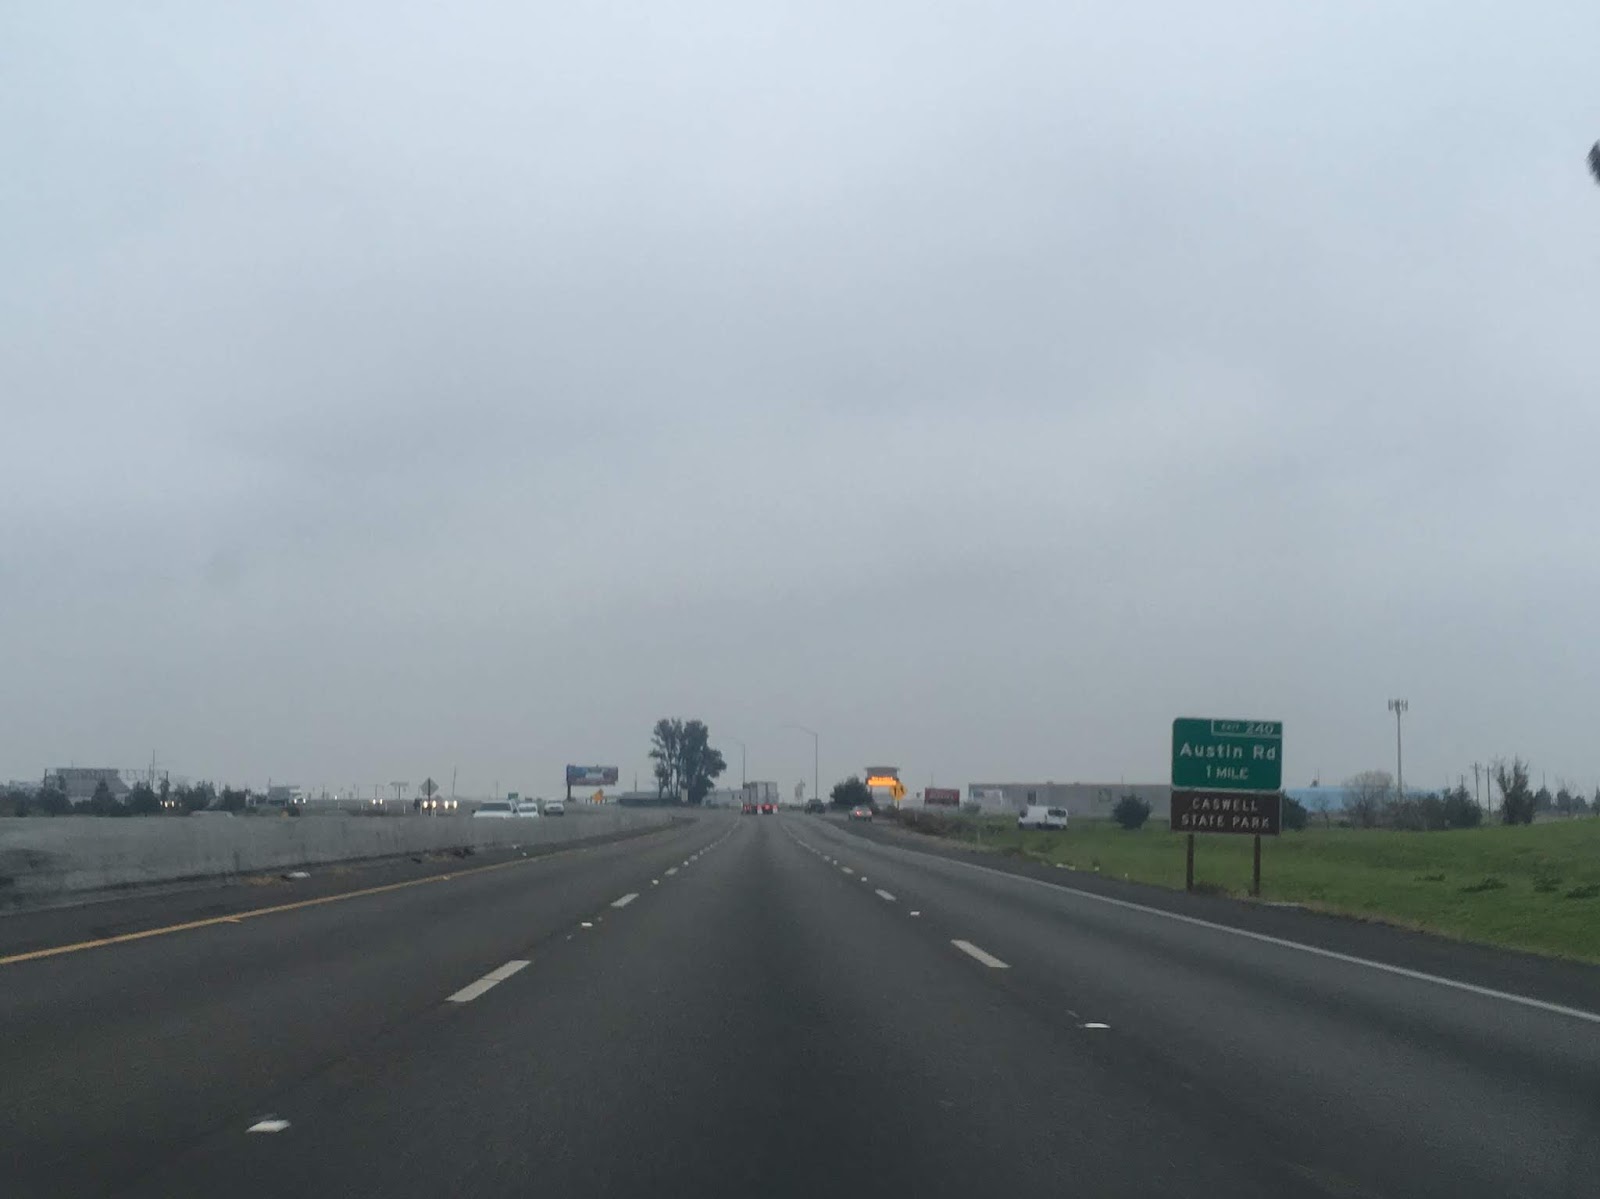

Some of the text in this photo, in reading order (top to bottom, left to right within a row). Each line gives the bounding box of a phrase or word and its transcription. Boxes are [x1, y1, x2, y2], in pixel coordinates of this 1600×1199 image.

[1246, 722, 1275, 736] 240
[1179, 742, 1276, 760] Austin Rd
[1206, 765, 1249, 779] 1 MILE
[1192, 797, 1258, 812] CASWELL
[1181, 813, 1270, 828] STATE PARK
